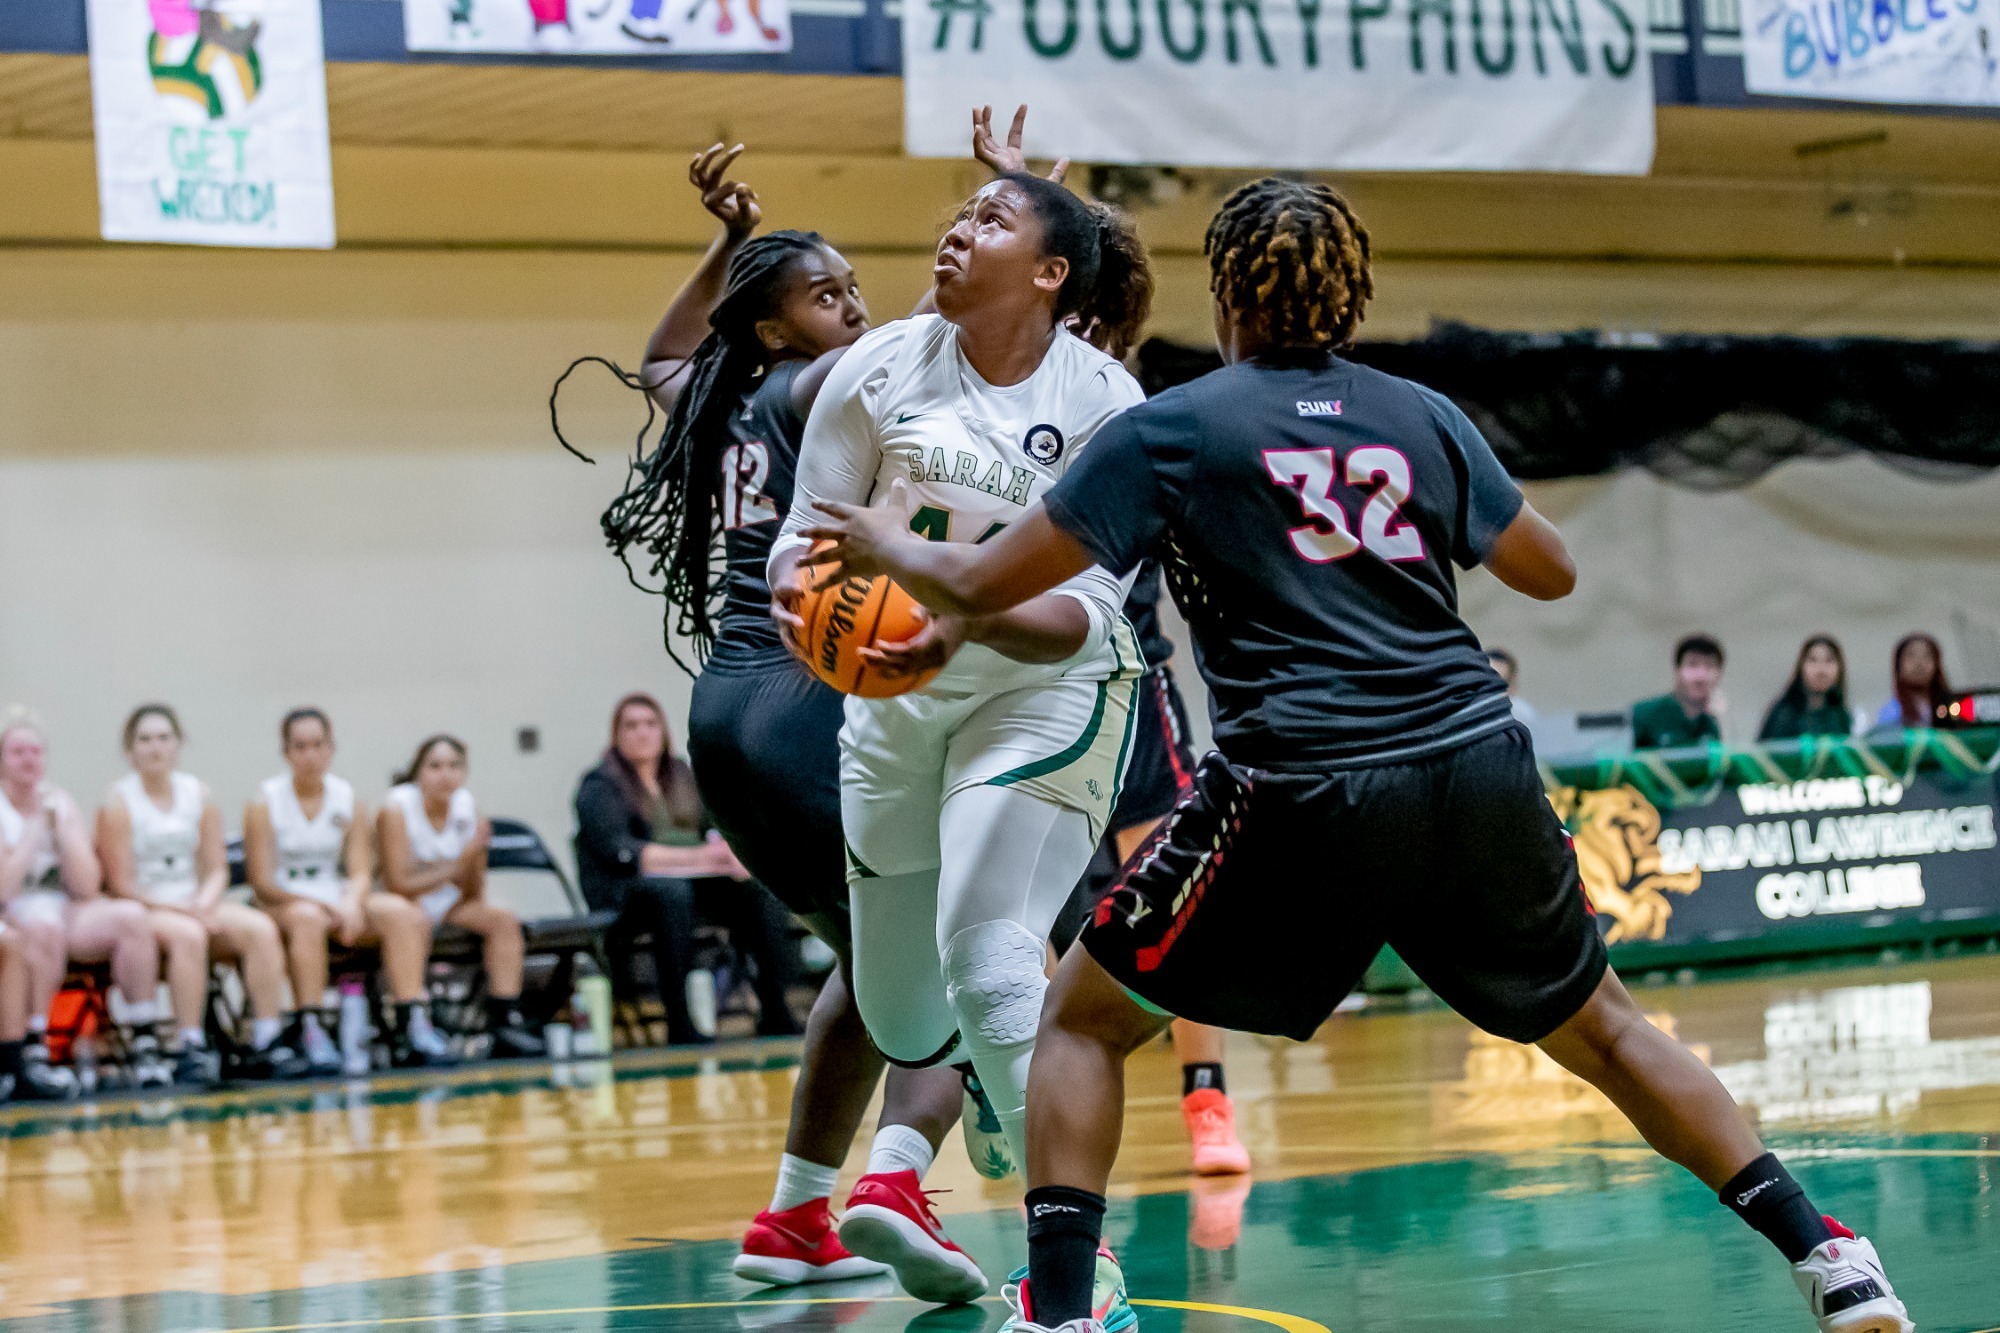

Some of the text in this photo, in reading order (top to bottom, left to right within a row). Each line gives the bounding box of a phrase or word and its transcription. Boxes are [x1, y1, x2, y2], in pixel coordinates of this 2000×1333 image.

[168, 126, 250, 172] GET
[1295, 400, 1342, 416] CUNY
[722, 441, 778, 530] 12
[908, 446, 1036, 507] SARAH
[1262, 444, 1427, 564] 32
[820, 576, 876, 673] Wilson
[1657, 819, 1794, 874] SARAH
